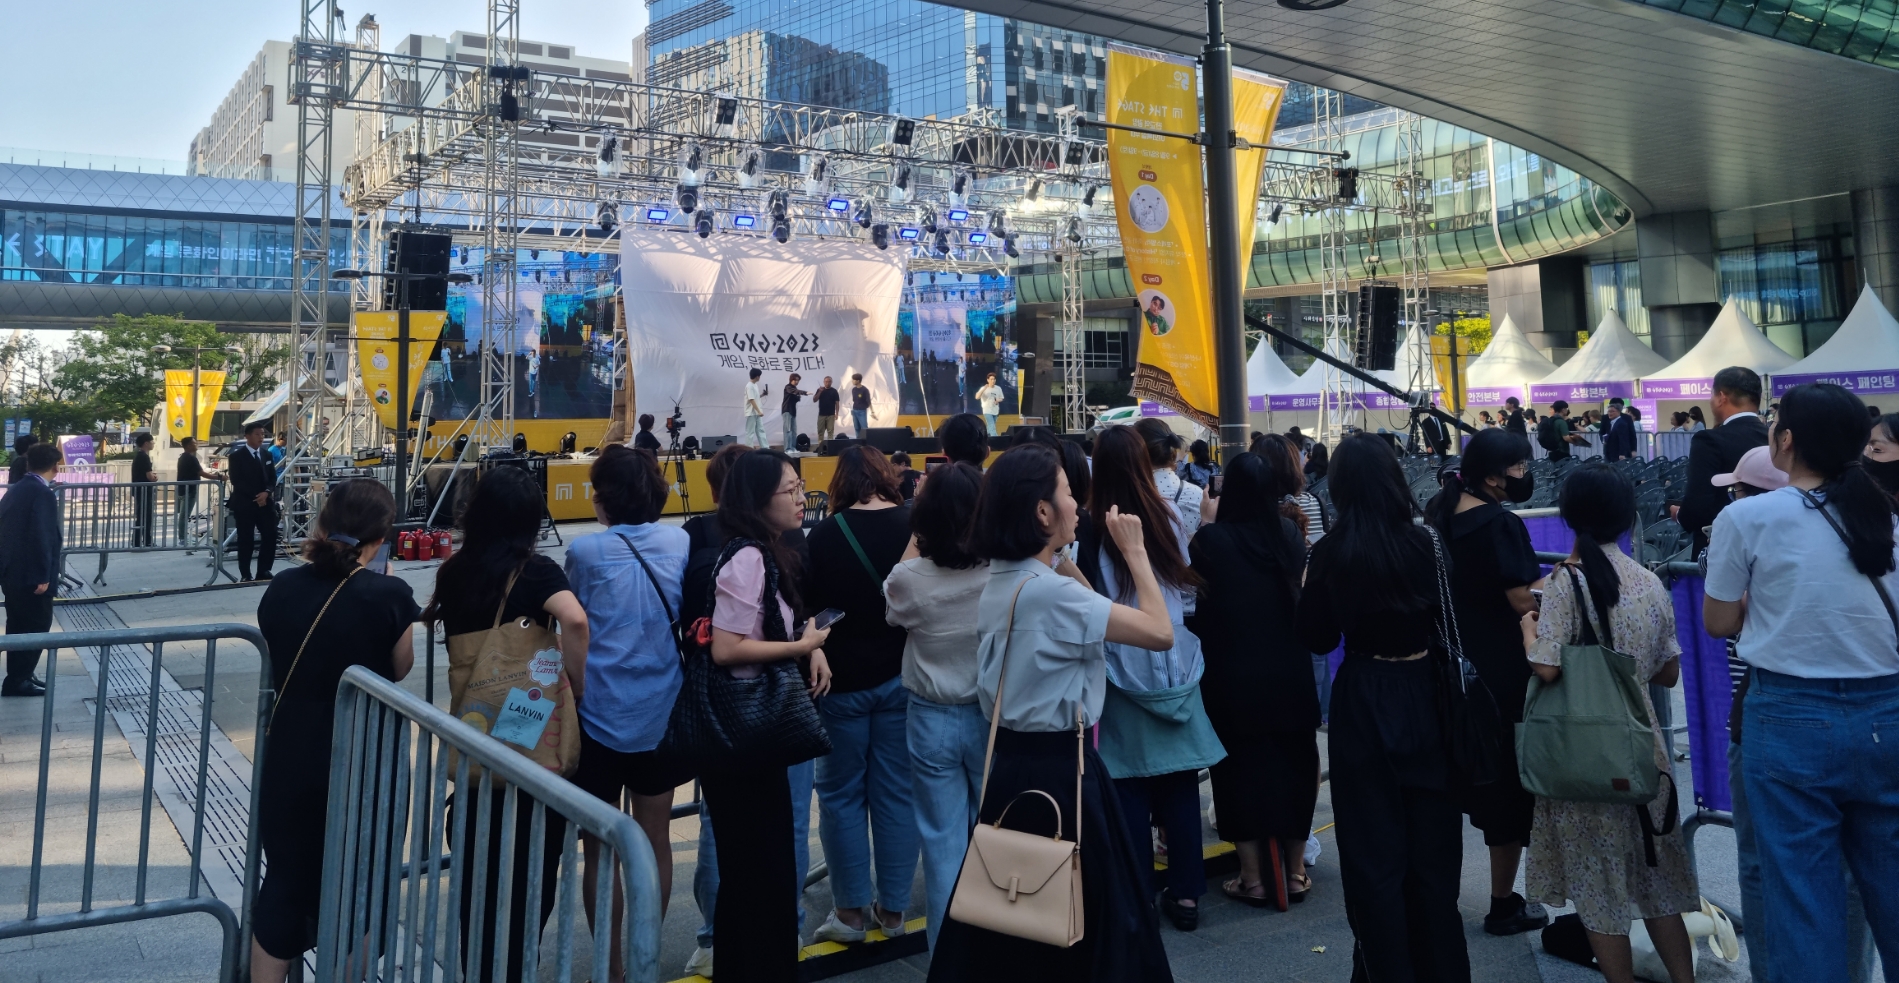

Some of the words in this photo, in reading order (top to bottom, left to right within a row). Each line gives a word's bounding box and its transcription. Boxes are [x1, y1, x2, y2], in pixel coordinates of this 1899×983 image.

[717, 354, 748, 370] 게임,
[748, 355, 782, 371] 문화로
[783, 355, 826, 372] 즐기다!
[1679, 382, 1711, 395] 페이스
[1857, 375, 1896, 389] 페인팅
[1467, 391, 1501, 403] 안전본부
[1570, 386, 1608, 399] 소방본부
[1292, 397, 1321, 408] 운영사무
[467, 677, 497, 689] MAISON
[498, 670, 527, 682] LANVIN
[508, 702, 545, 721] LANVIN
